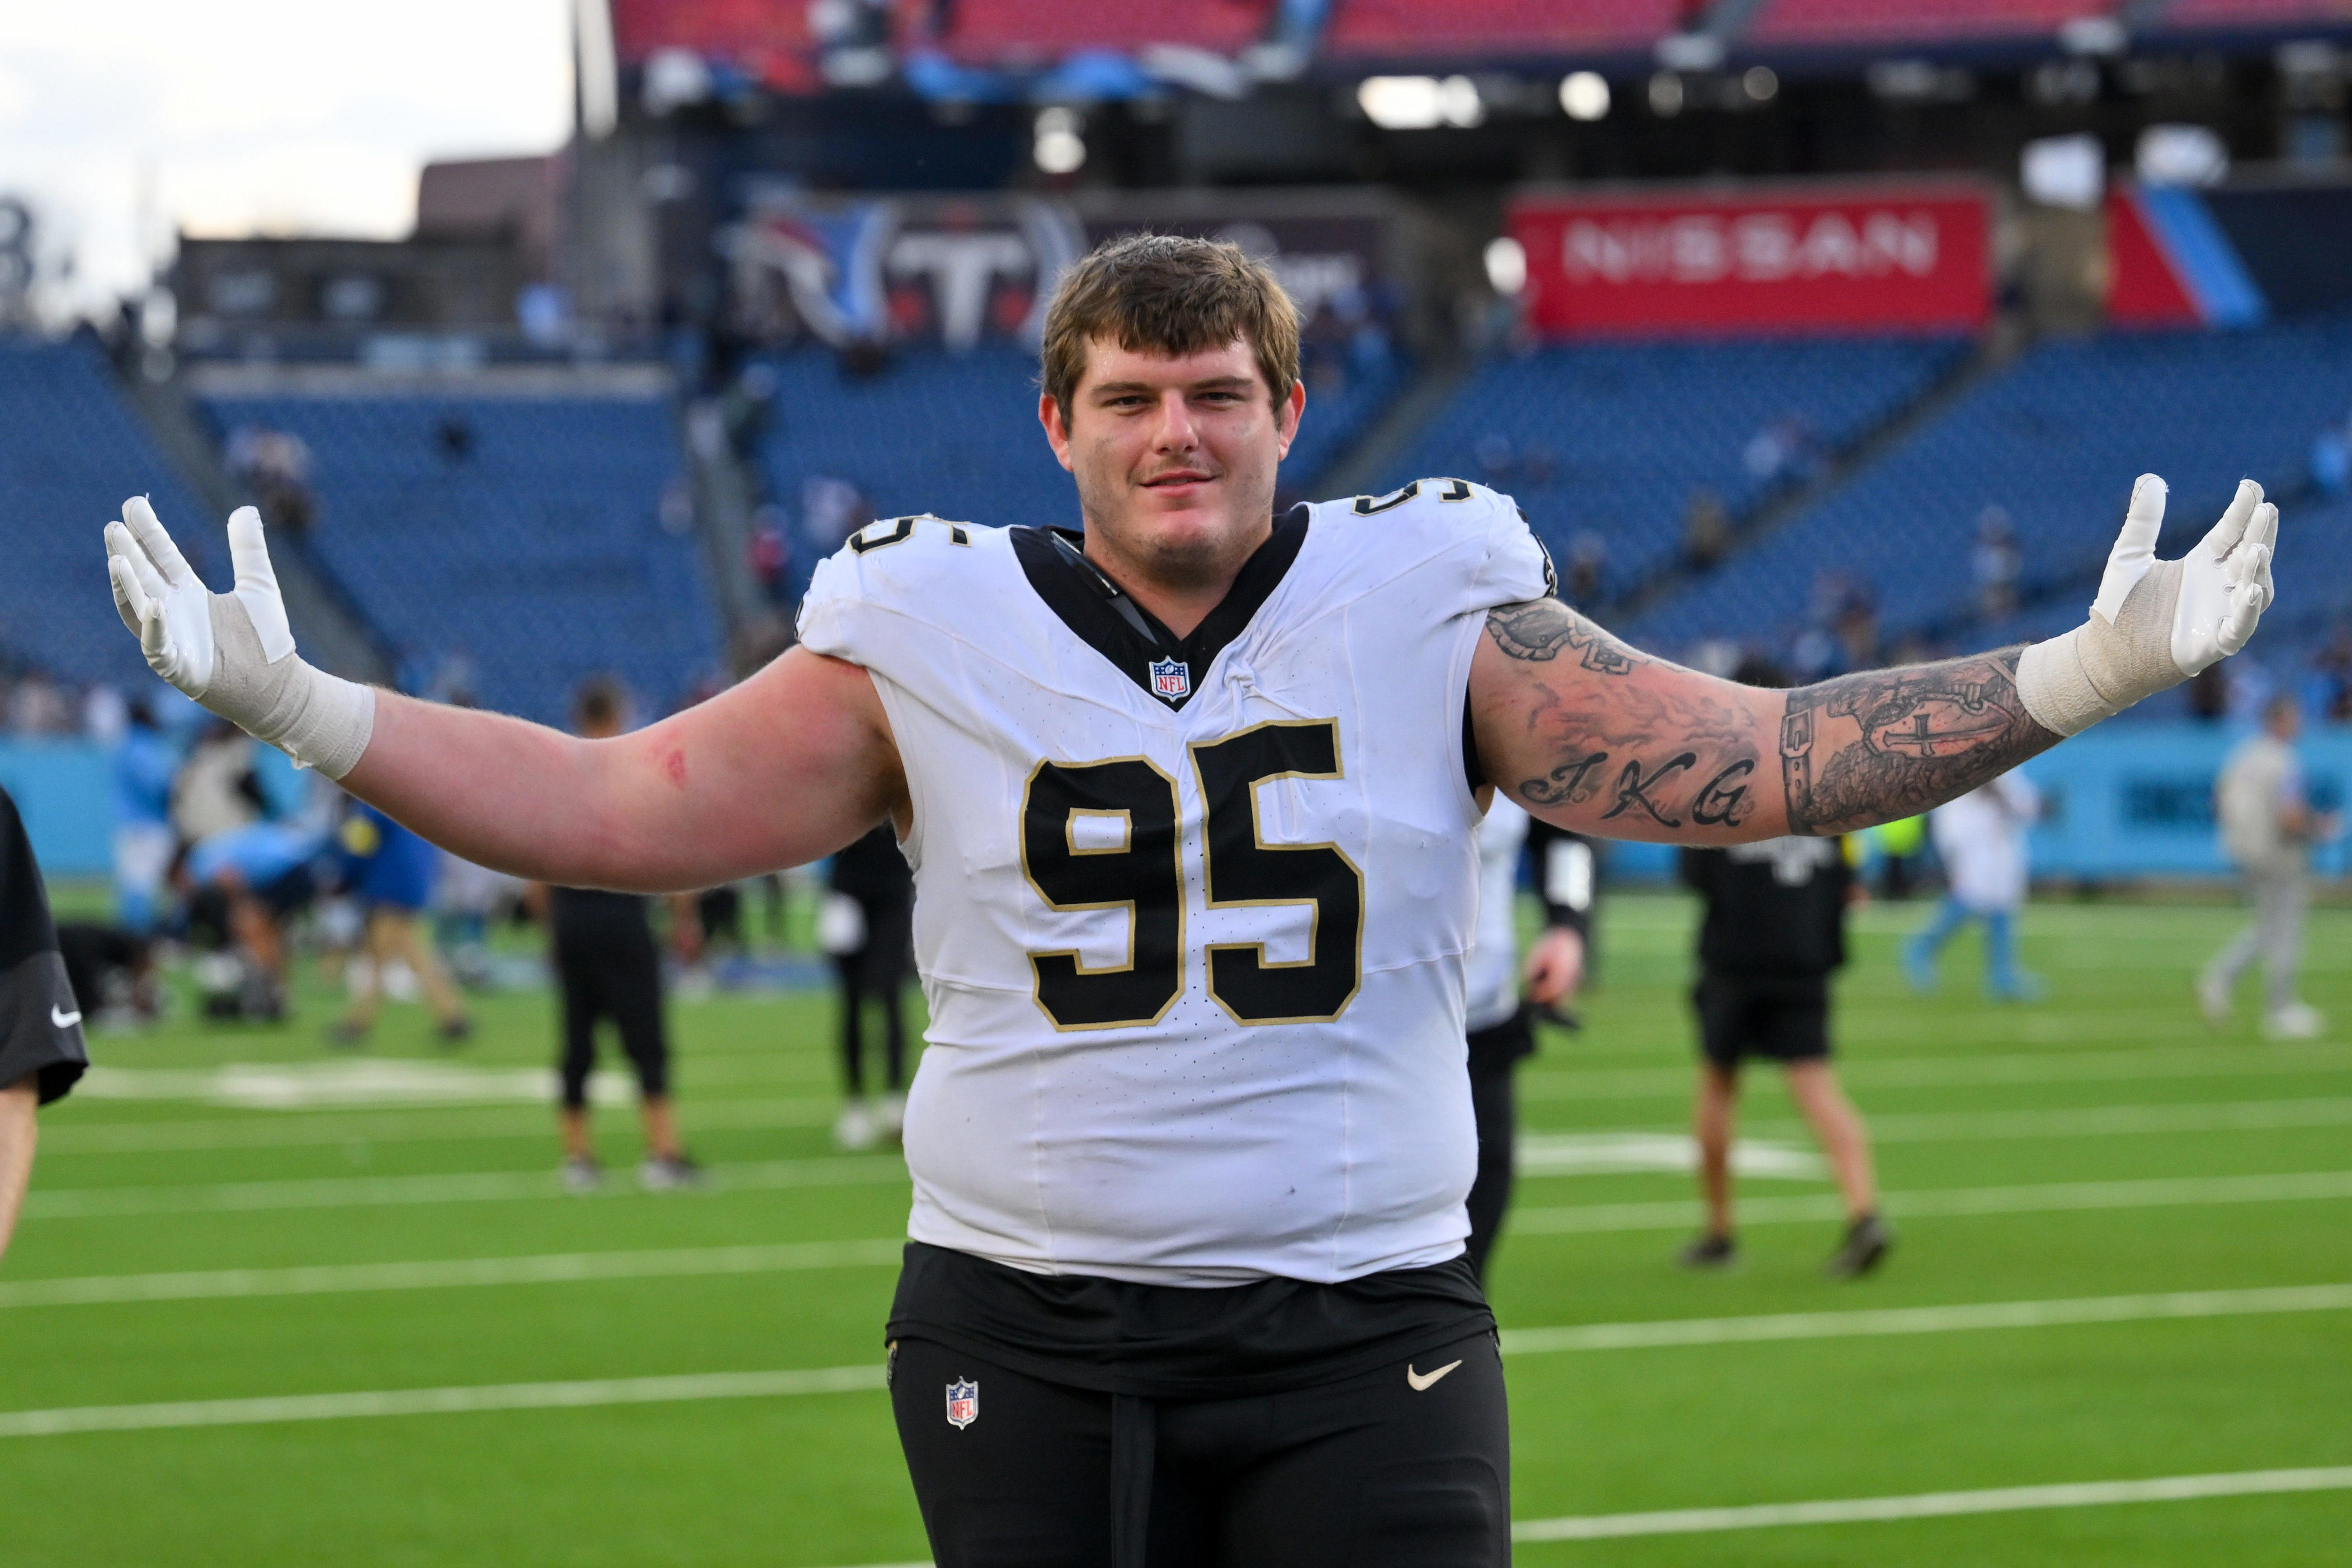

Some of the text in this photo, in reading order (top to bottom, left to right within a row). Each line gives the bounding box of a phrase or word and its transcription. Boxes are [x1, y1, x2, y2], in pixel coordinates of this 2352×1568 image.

[1564, 210, 1938, 281] NISSAN
[1159, 676, 1184, 692] NFL
[1019, 716, 1366, 1032] 95
[952, 1400, 973, 1419] NFL
